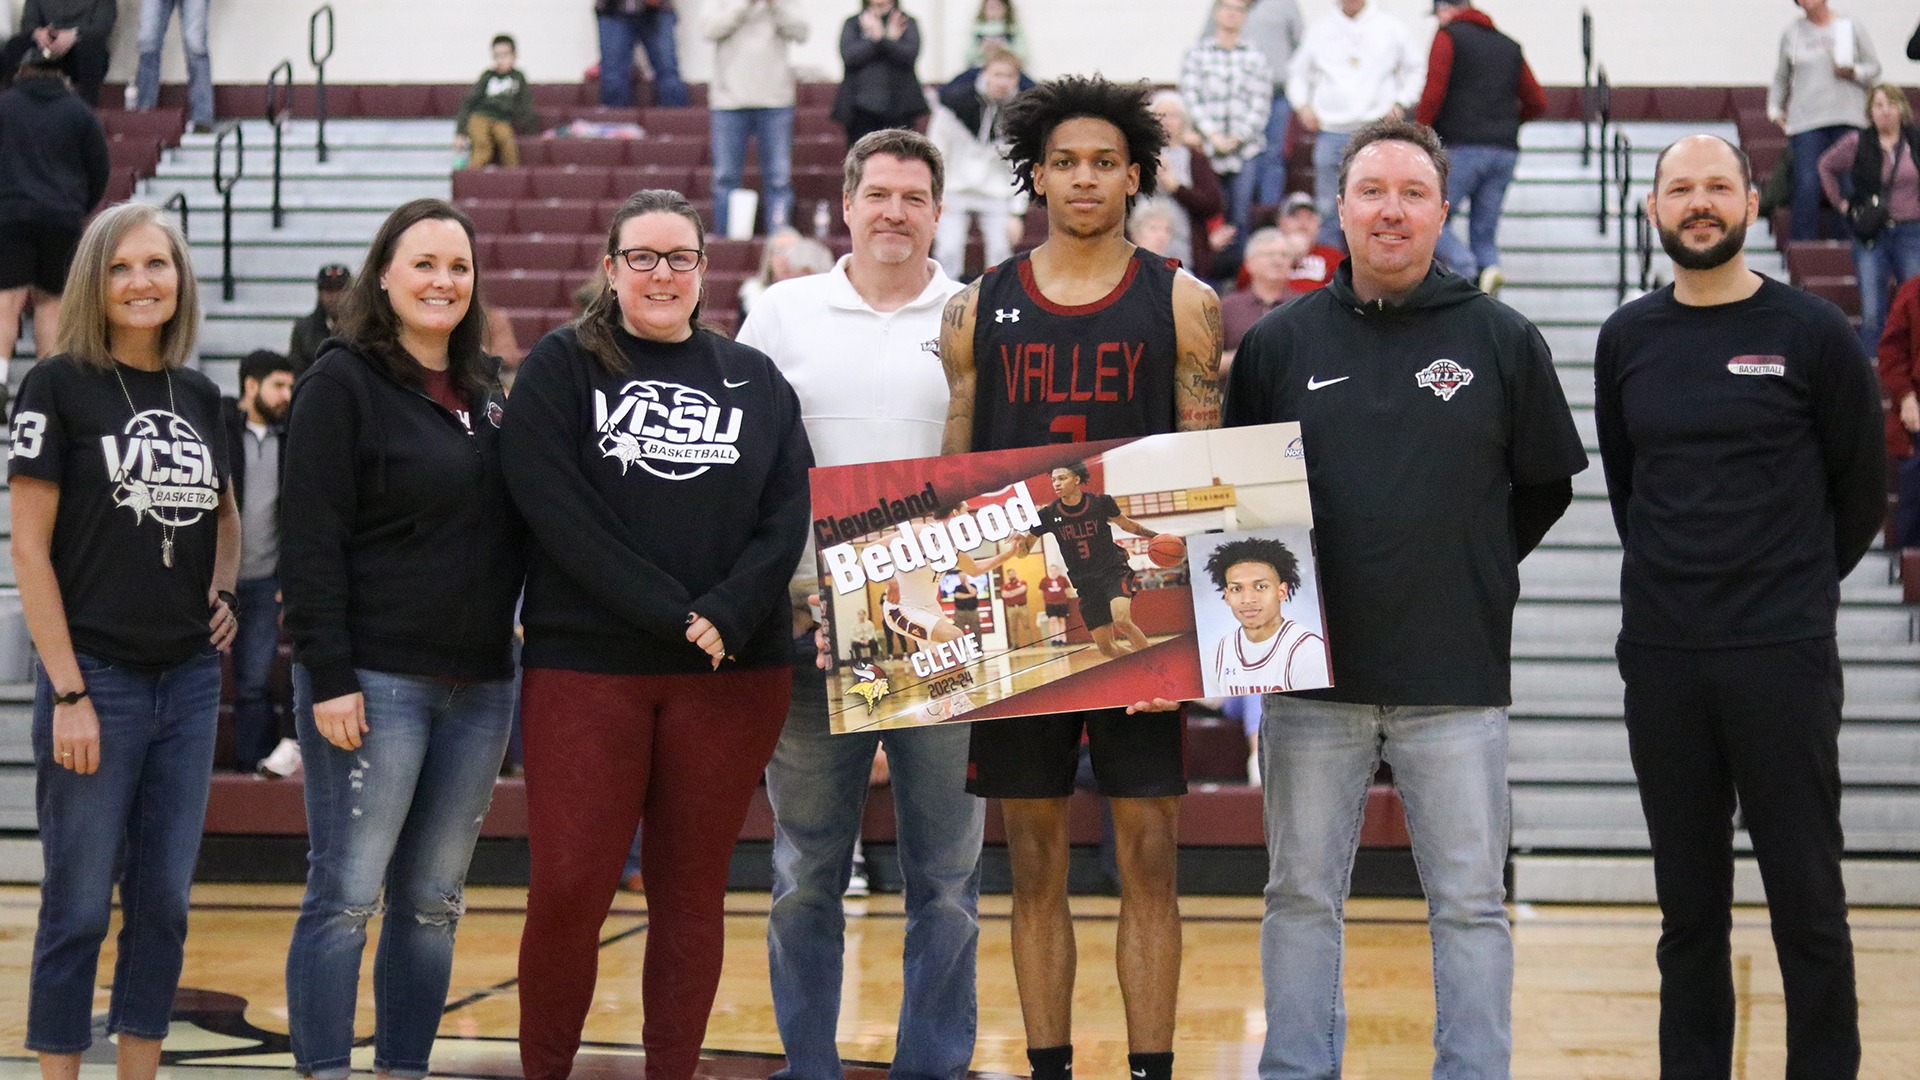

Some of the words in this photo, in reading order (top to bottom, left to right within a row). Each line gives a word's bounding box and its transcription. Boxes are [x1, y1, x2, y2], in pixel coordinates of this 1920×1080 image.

[1001, 342, 1145, 404] VALLEY
[1420, 370, 1470, 384] VALLEY
[1738, 365, 1783, 375] BASKETBALL
[595, 389, 744, 443] VCSU
[8, 411, 47, 460] 3
[649, 443, 736, 460] BASKETBALL
[155, 491, 215, 505] BASKETBA
[813, 481, 941, 545] Cleveland
[822, 480, 1042, 596] Bedgood
[1058, 519, 1099, 540] VALLEY
[1077, 540, 1091, 559] 3
[910, 632, 984, 678] CLEVE
[927, 670, 974, 699] 2022-24
